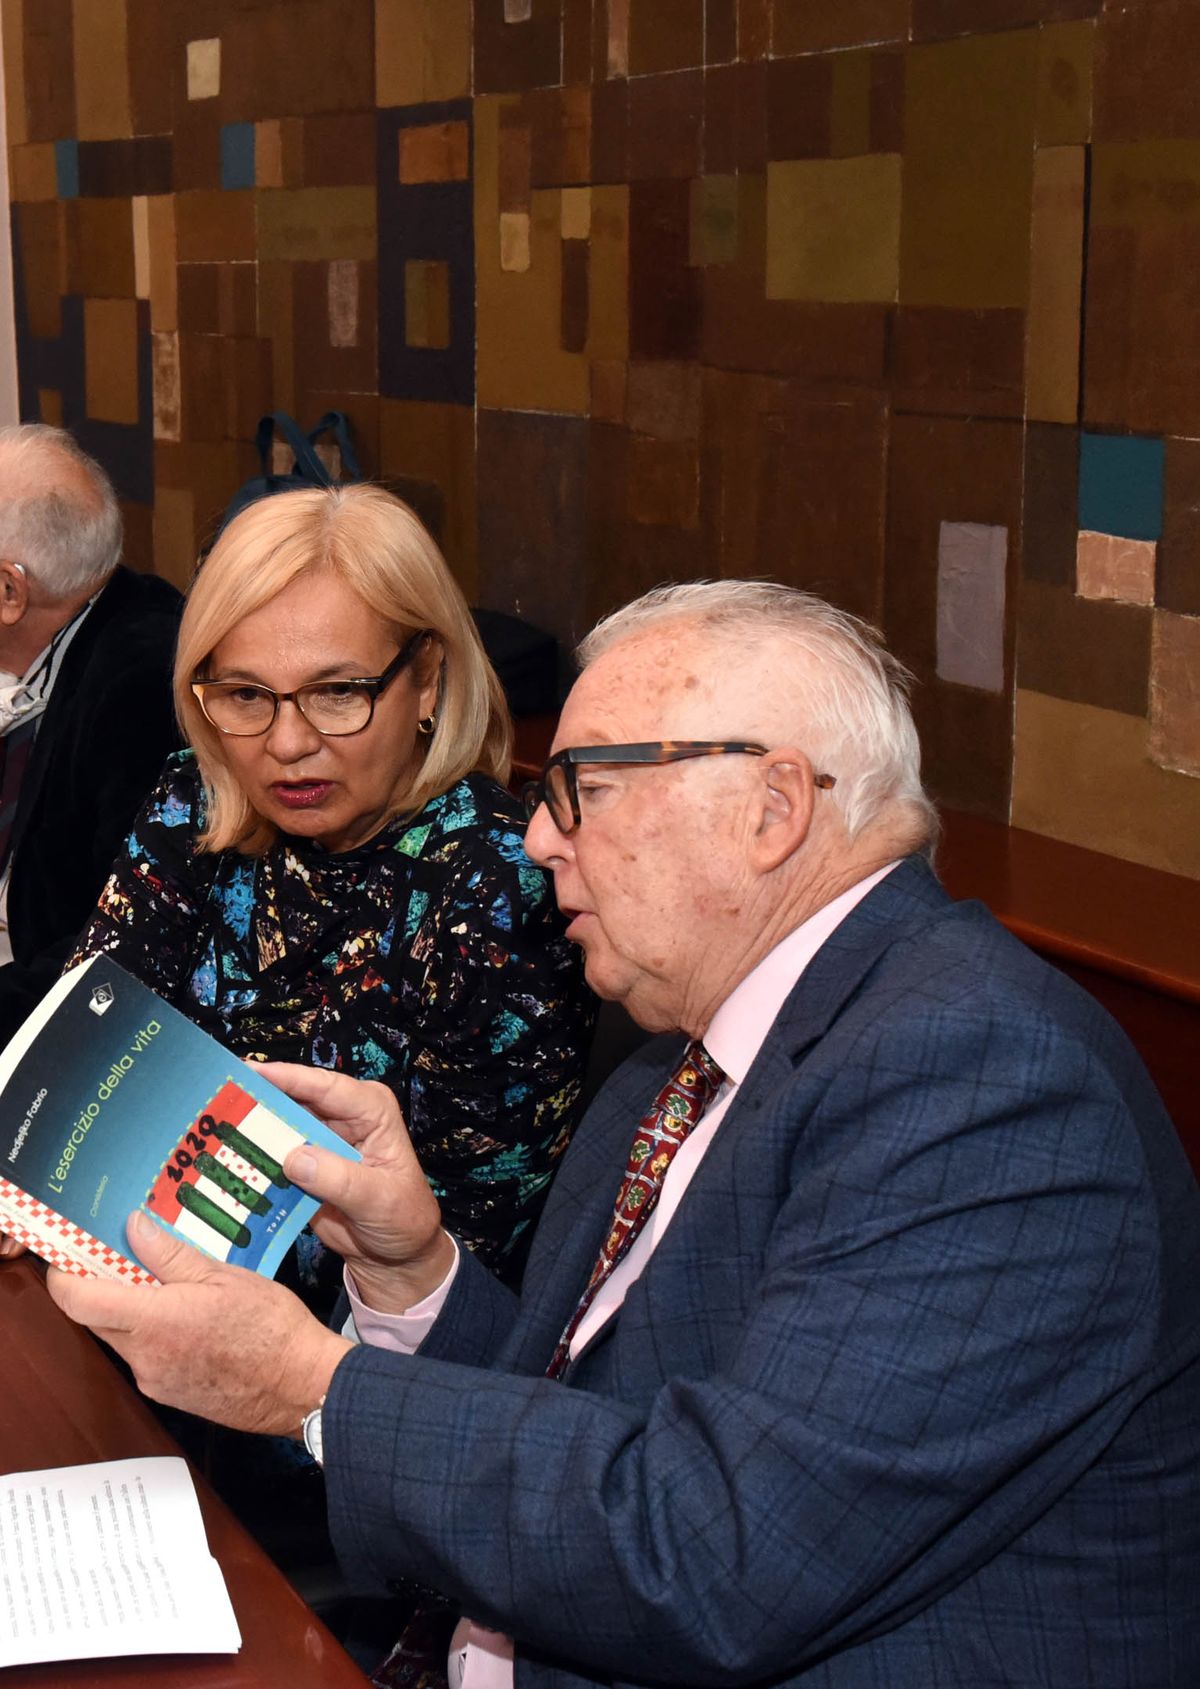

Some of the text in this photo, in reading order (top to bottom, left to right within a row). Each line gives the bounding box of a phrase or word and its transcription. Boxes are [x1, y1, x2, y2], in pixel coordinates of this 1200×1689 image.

[27, 1087, 48, 1119] Fabrio
[48, 1102, 100, 1193] L'esercizio
[98, 1054, 135, 1100] della
[130, 1019, 162, 1052] vita
